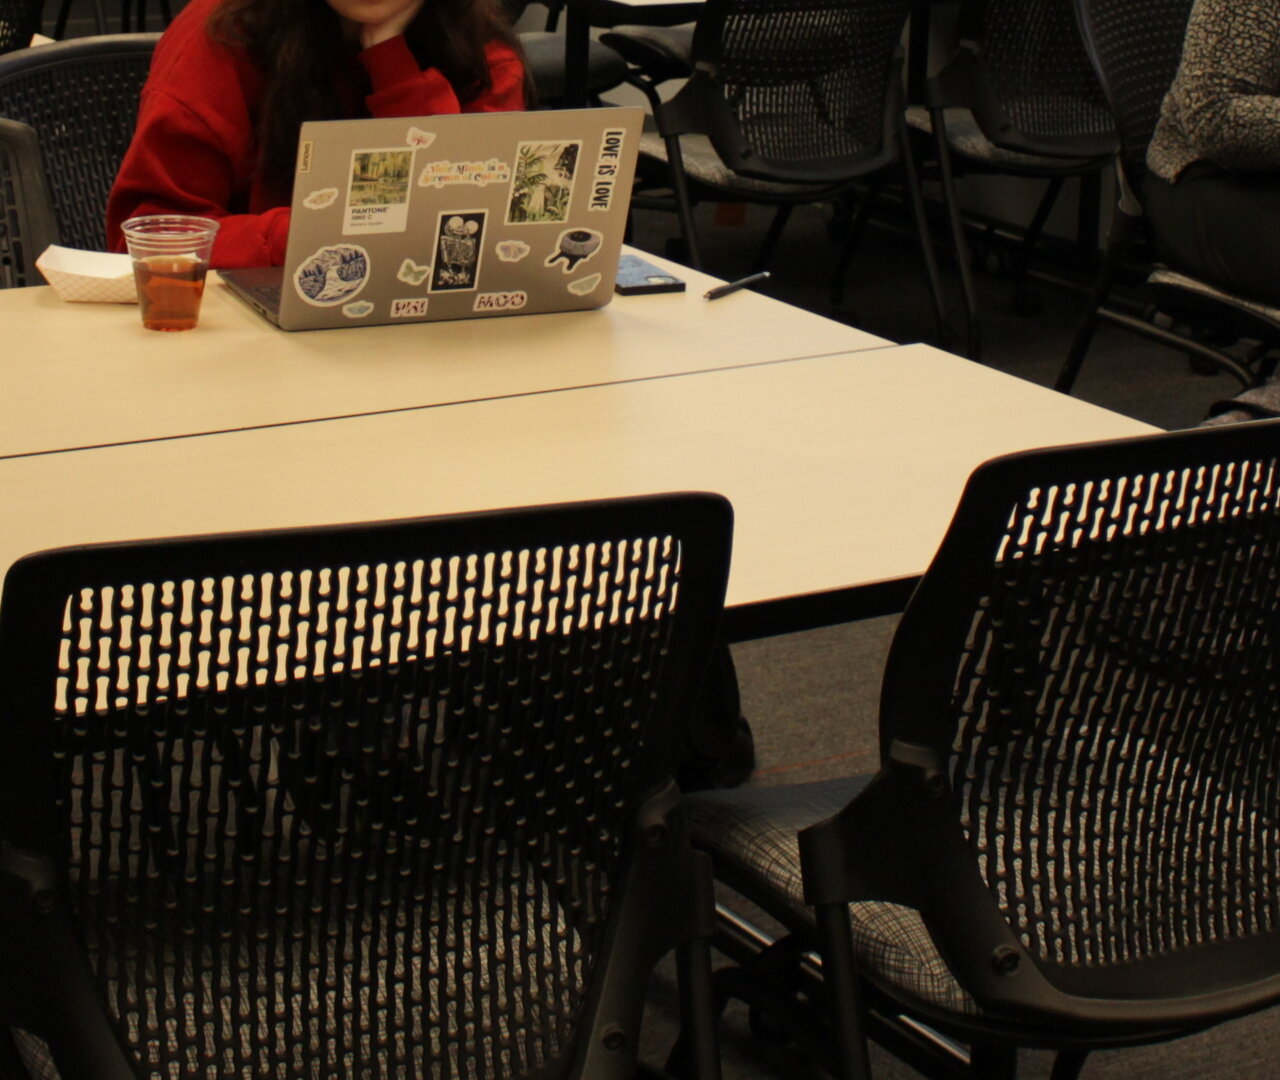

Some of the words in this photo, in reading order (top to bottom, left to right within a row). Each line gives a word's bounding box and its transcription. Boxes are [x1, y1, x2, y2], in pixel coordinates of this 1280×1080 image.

[601, 131, 623, 159] LOVE
[591, 181, 613, 209] LOVE
[351, 207, 387, 215] PANTONE
